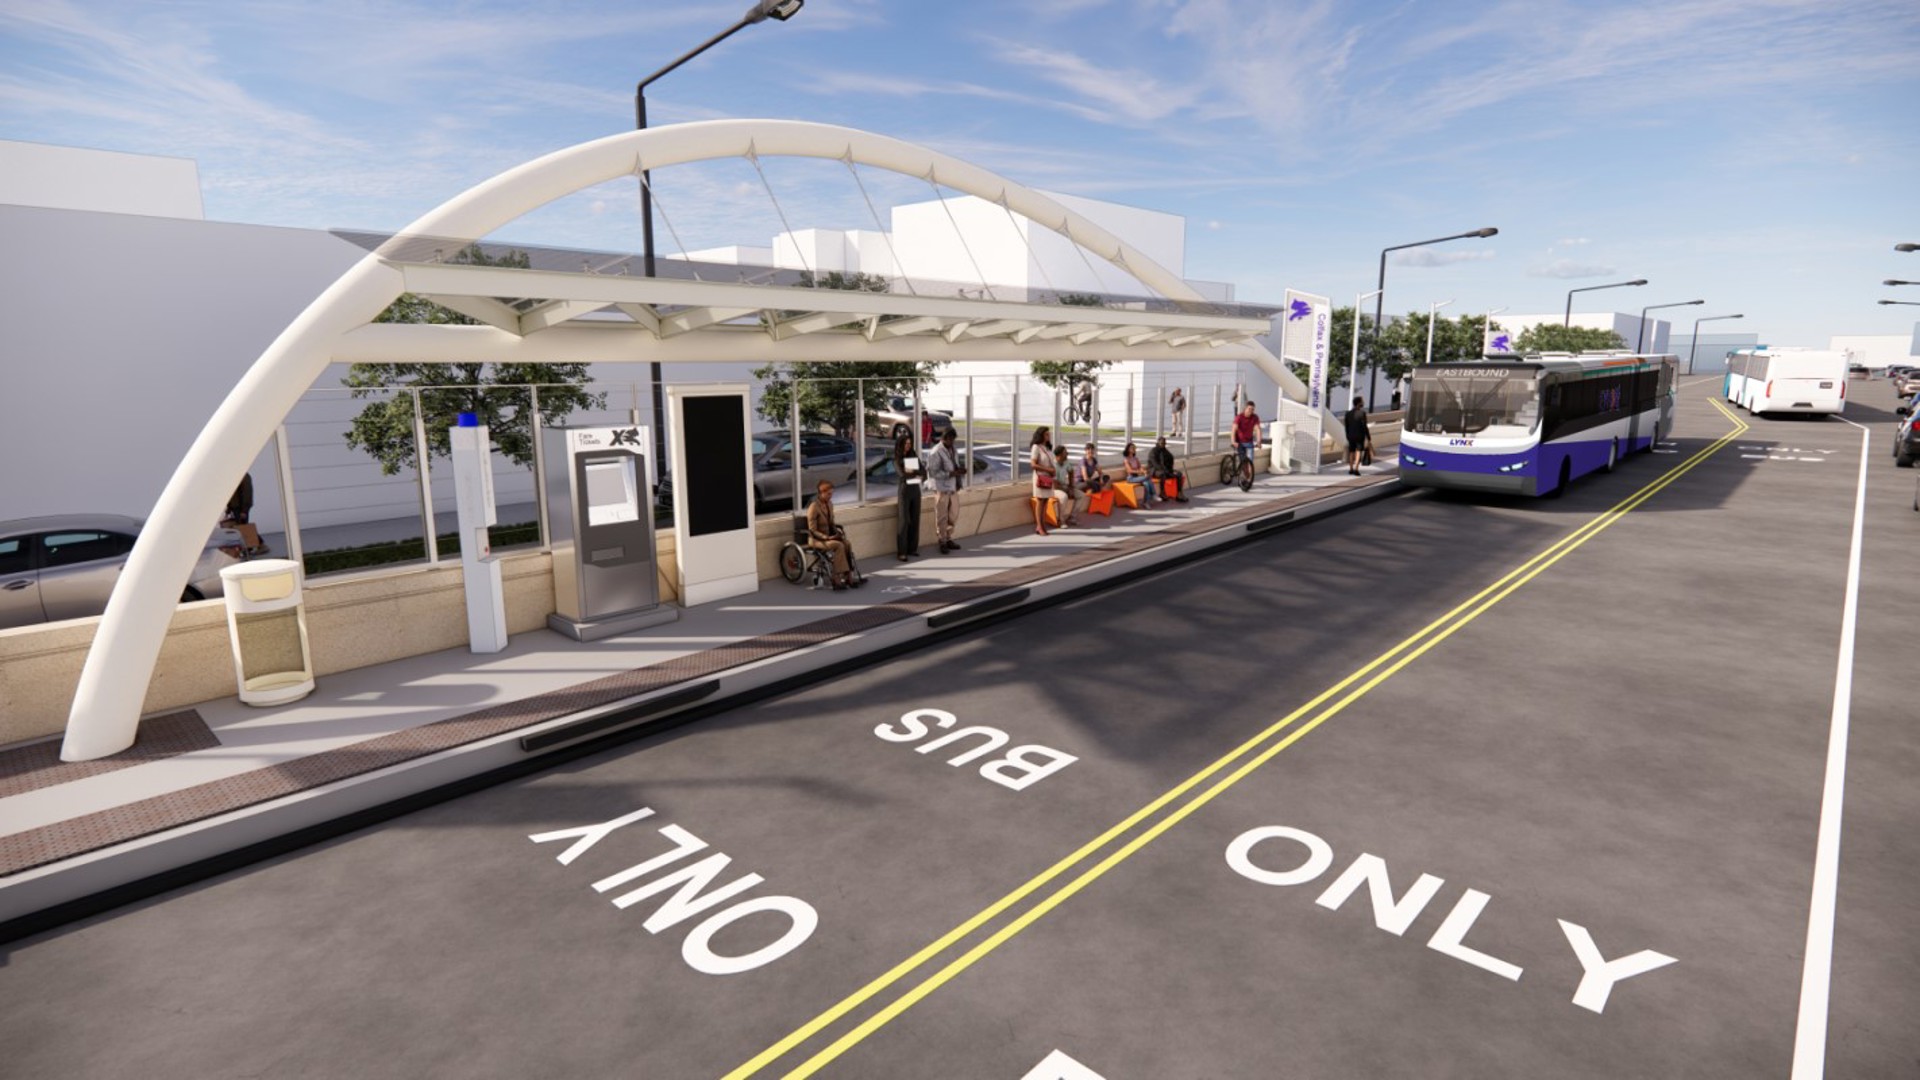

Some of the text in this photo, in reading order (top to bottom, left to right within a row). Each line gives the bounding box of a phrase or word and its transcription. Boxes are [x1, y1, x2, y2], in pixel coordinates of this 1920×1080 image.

[1318, 313, 1327, 340] Colfax
[1436, 368, 1510, 377] EASTBOUND
[874, 708, 1079, 791] BUS
[528, 807, 818, 974] ONLY
[1225, 825, 1679, 1014] ONLY
